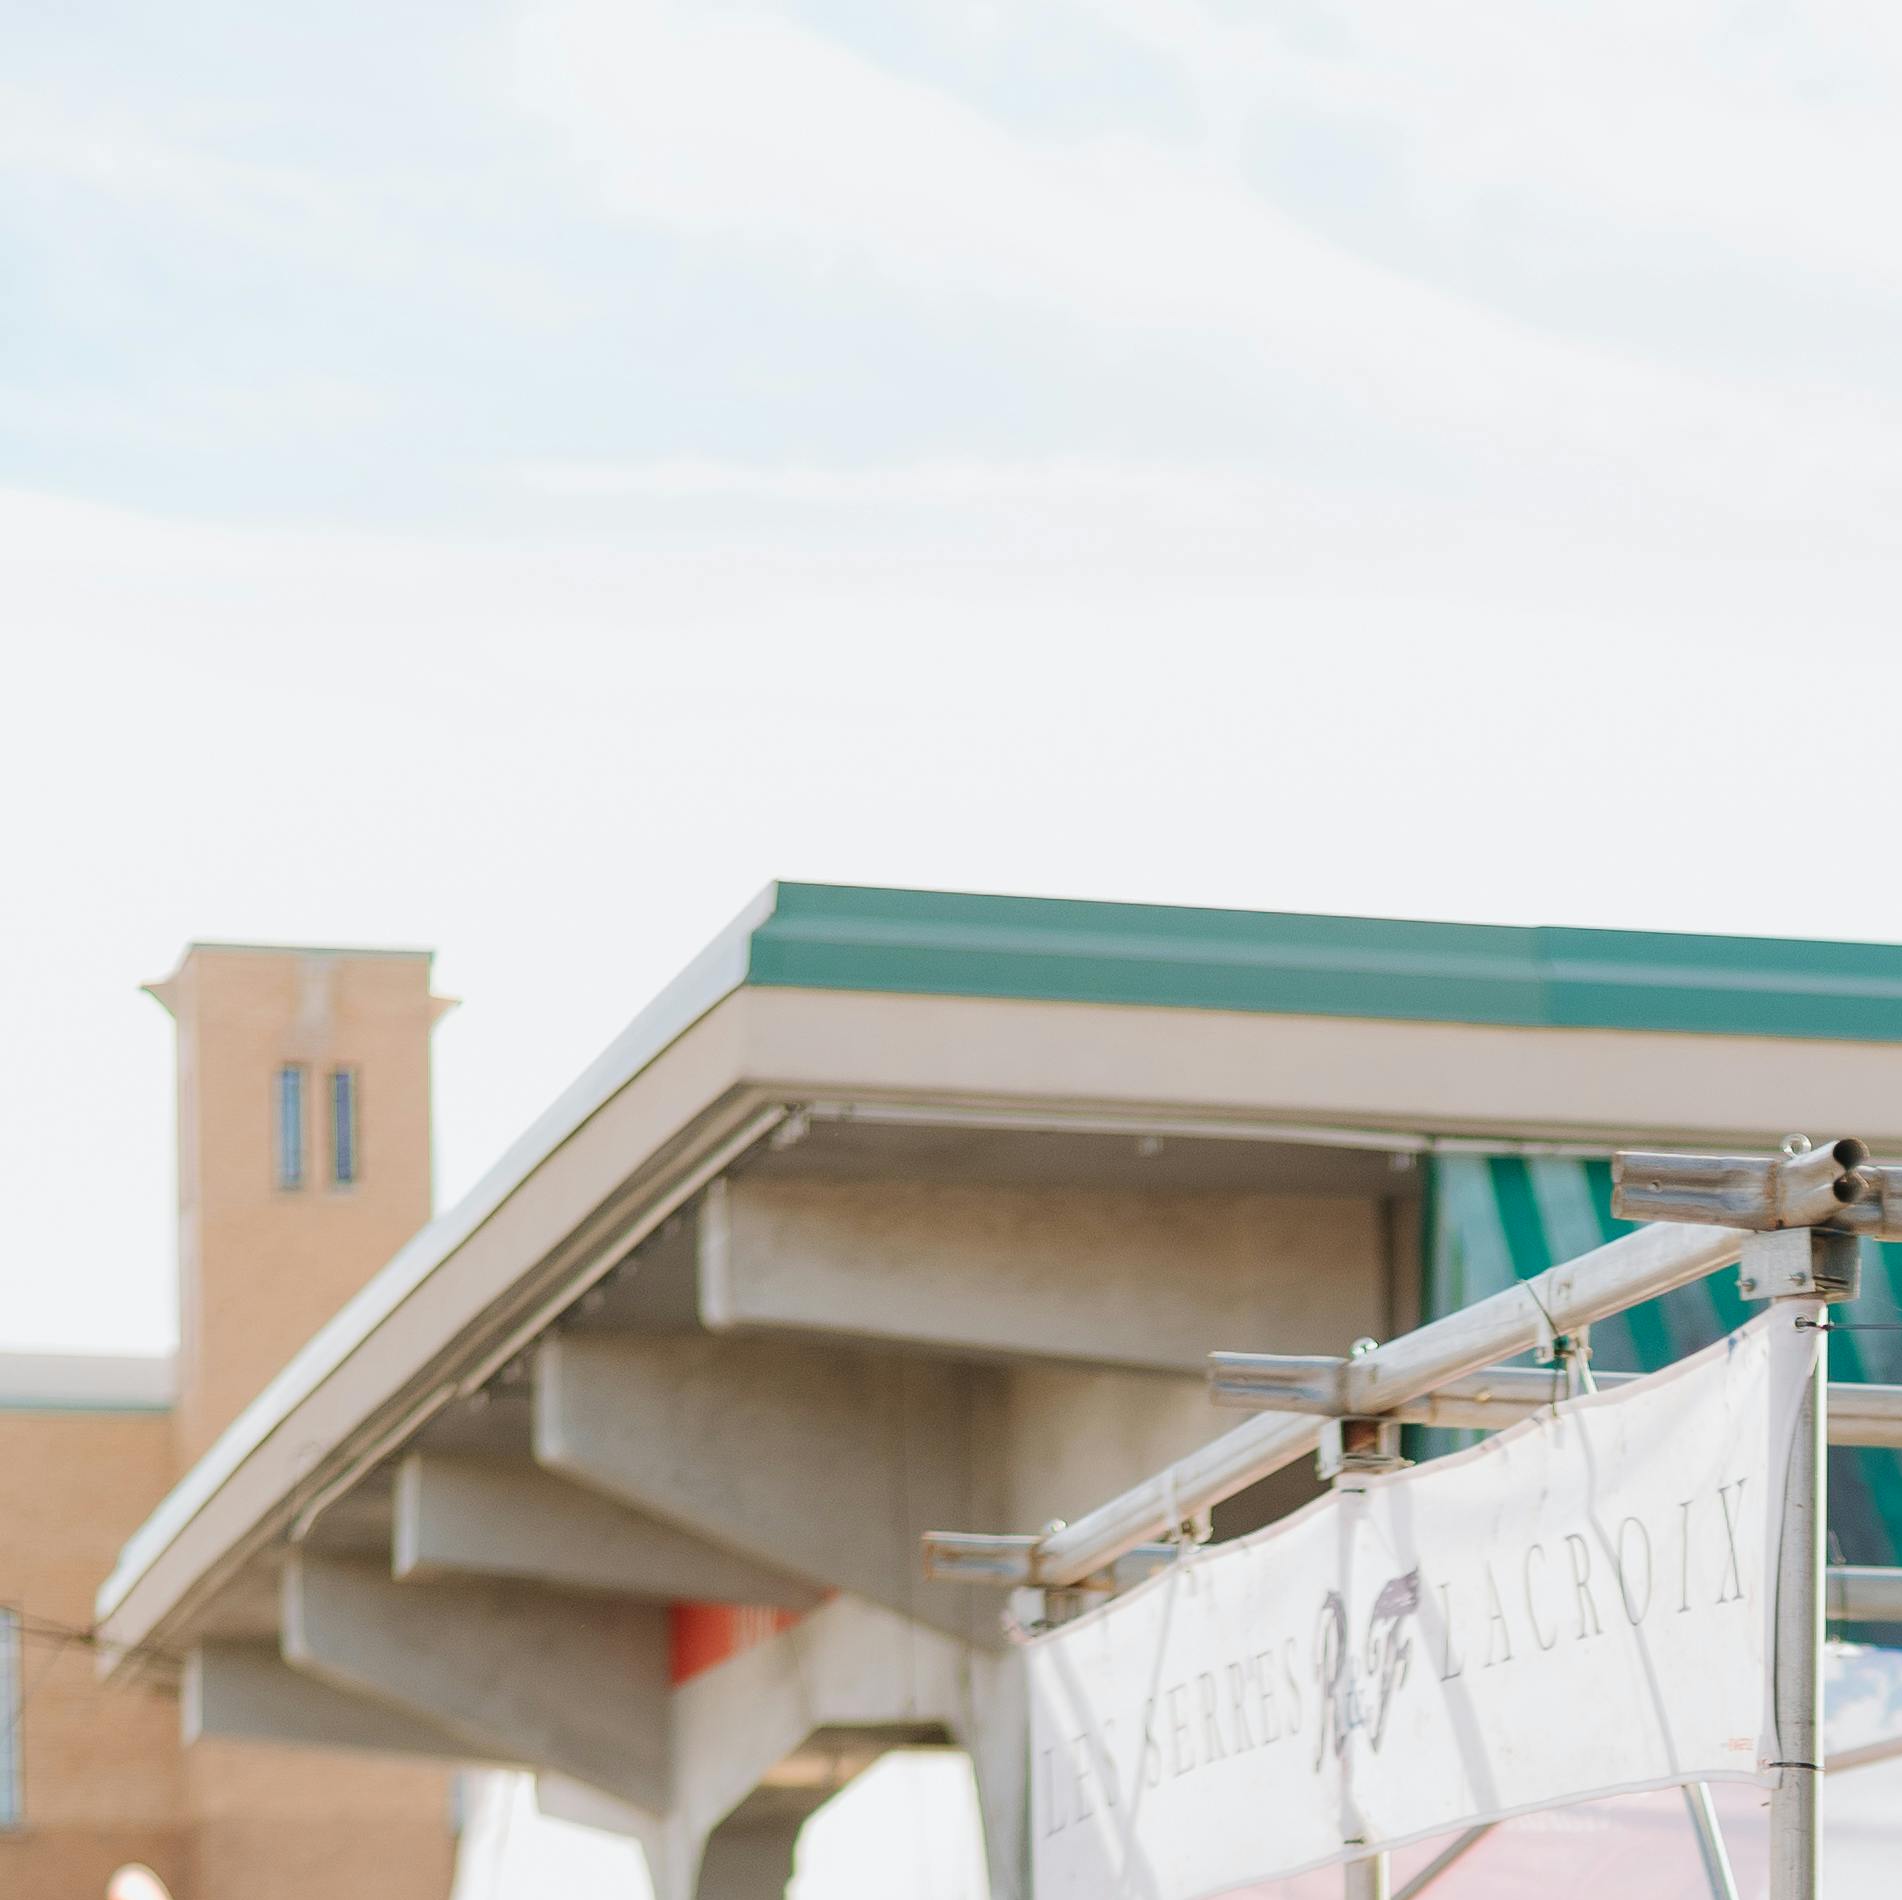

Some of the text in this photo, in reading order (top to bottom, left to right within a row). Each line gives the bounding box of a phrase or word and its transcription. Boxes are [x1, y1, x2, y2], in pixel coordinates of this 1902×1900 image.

[1043, 1717, 1120, 1839] LES
[1142, 1635, 1304, 1790] SERRES
[1438, 1477, 1748, 1683] LACROIX
